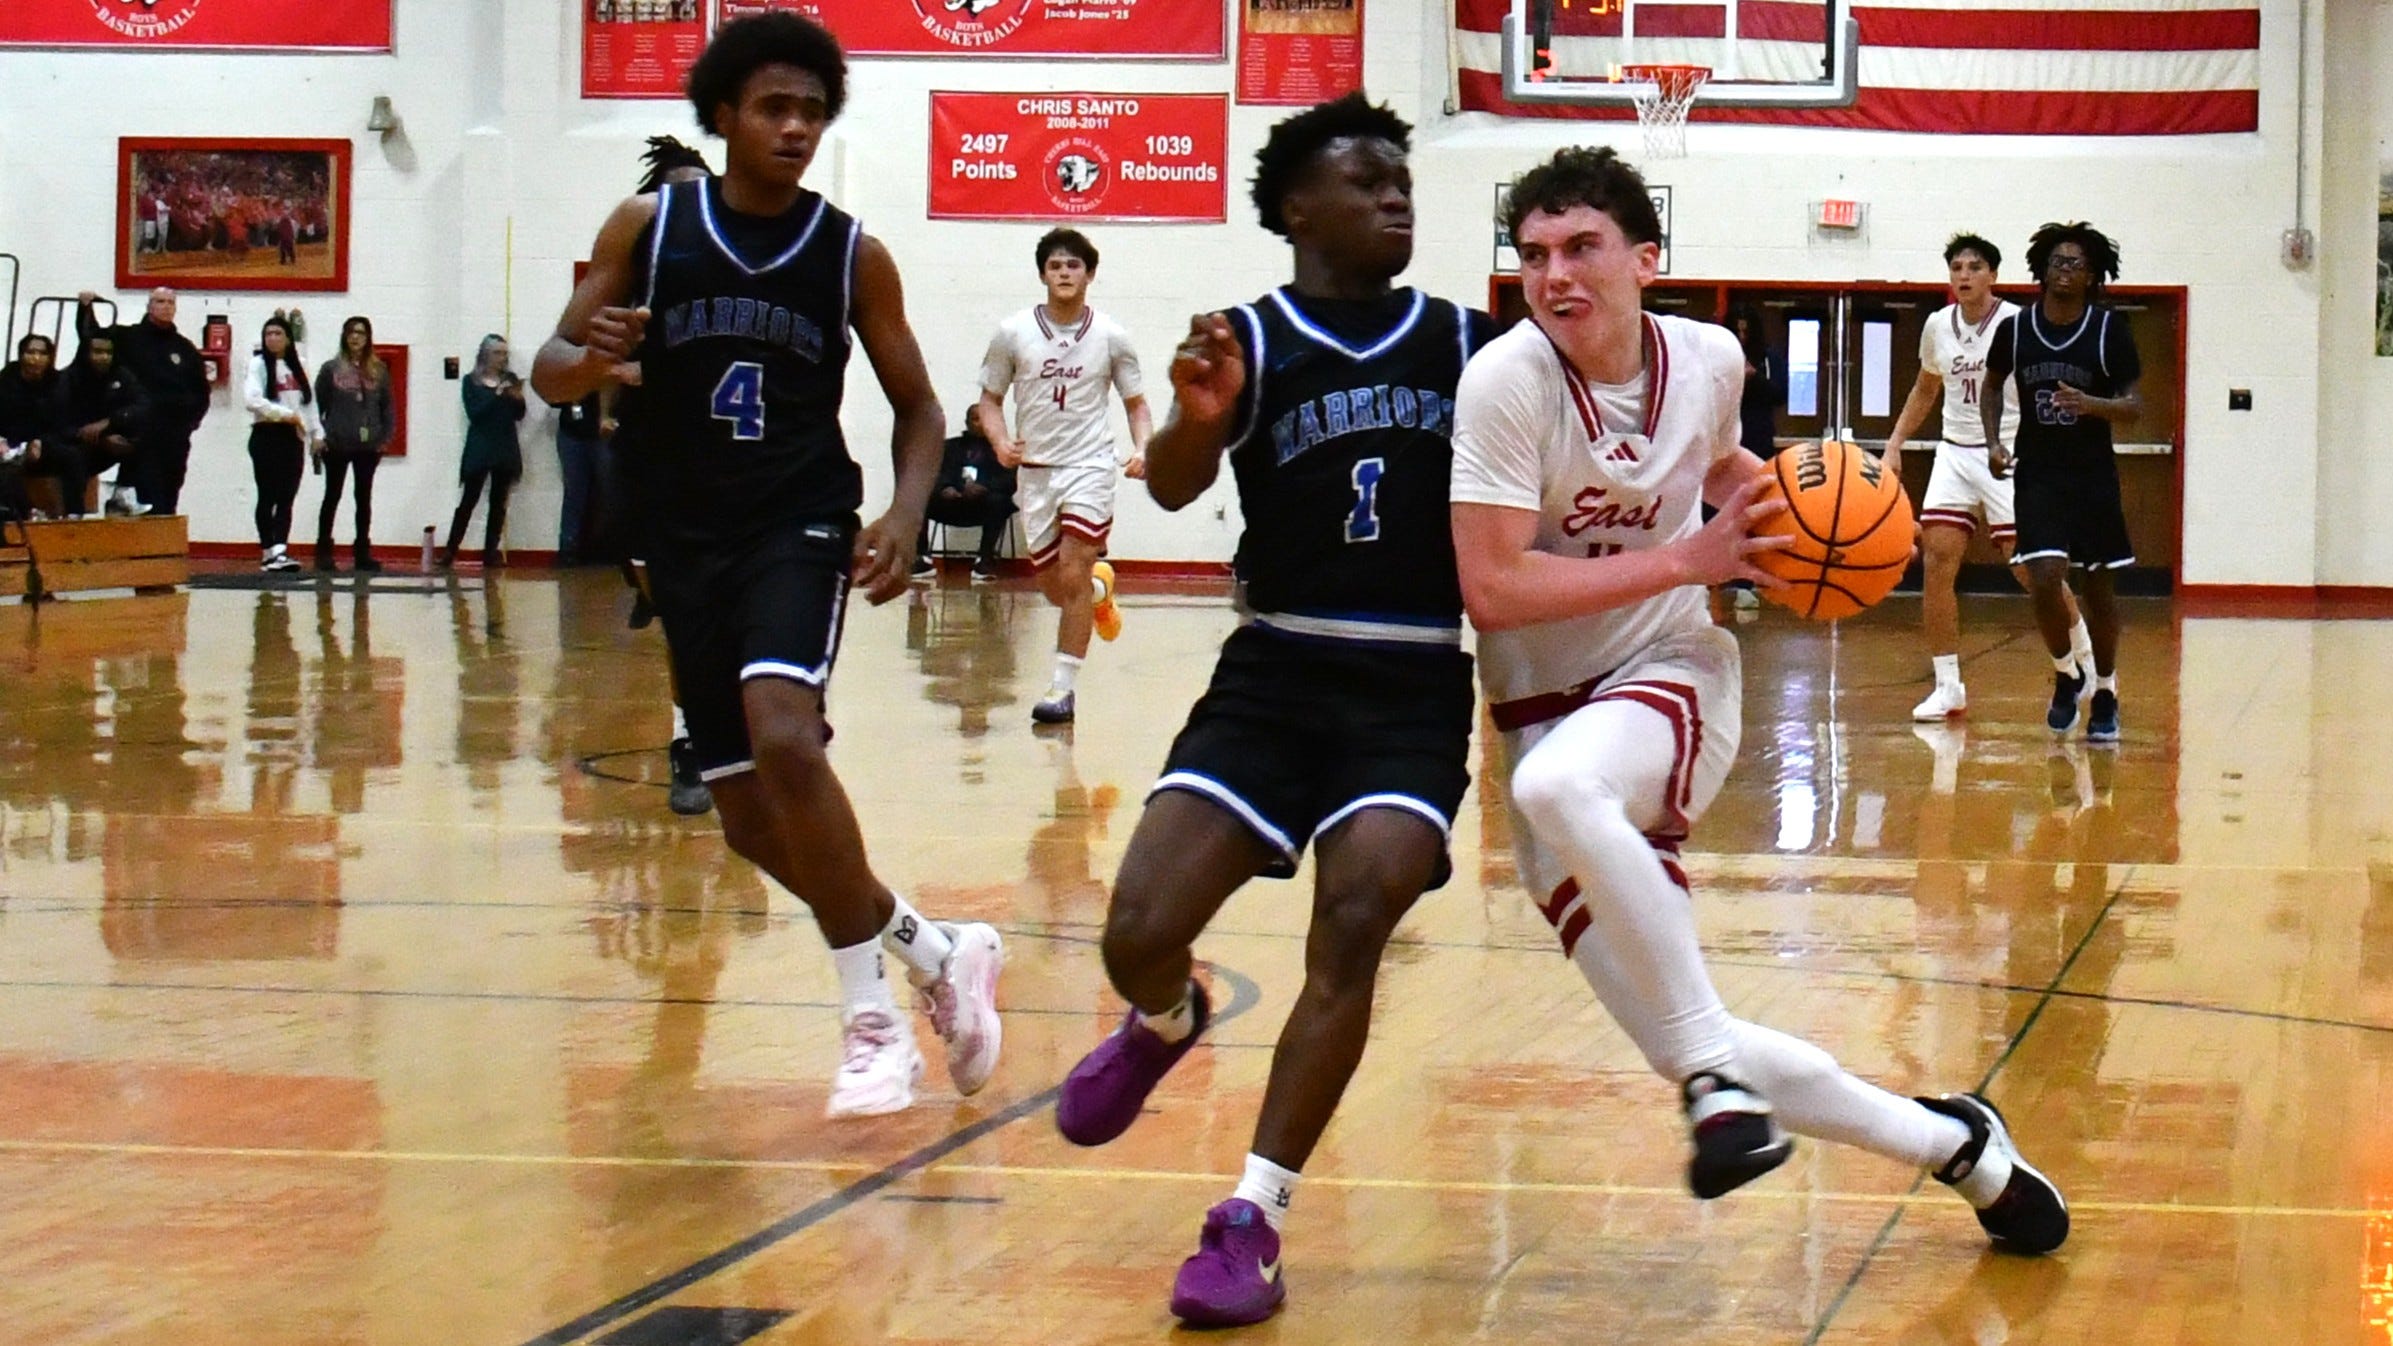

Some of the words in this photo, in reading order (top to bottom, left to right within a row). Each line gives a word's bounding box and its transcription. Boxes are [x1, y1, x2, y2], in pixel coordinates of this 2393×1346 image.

[96, 6, 196, 37] BASKETBALL
[921, 15, 1023, 46] BASKETBALL
[1017, 100, 1072, 115] CHRIS
[1077, 101, 1139, 116] SANTO
[1046, 117, 1109, 129] 2008-2011
[960, 134, 1009, 153] 2497
[1145, 136, 1192, 155] 1039
[952, 160, 1017, 179] Points
[1121, 161, 1217, 181] Rebounds
[664, 296, 824, 364] WARRIORS
[1040, 358, 1083, 379] East
[1951, 355, 1984, 375] East
[711, 361, 766, 441] 4
[1052, 384, 1067, 411] 4
[1961, 378, 1977, 404] 21
[1344, 457, 1386, 543] 1
[1562, 486, 1663, 537] East
